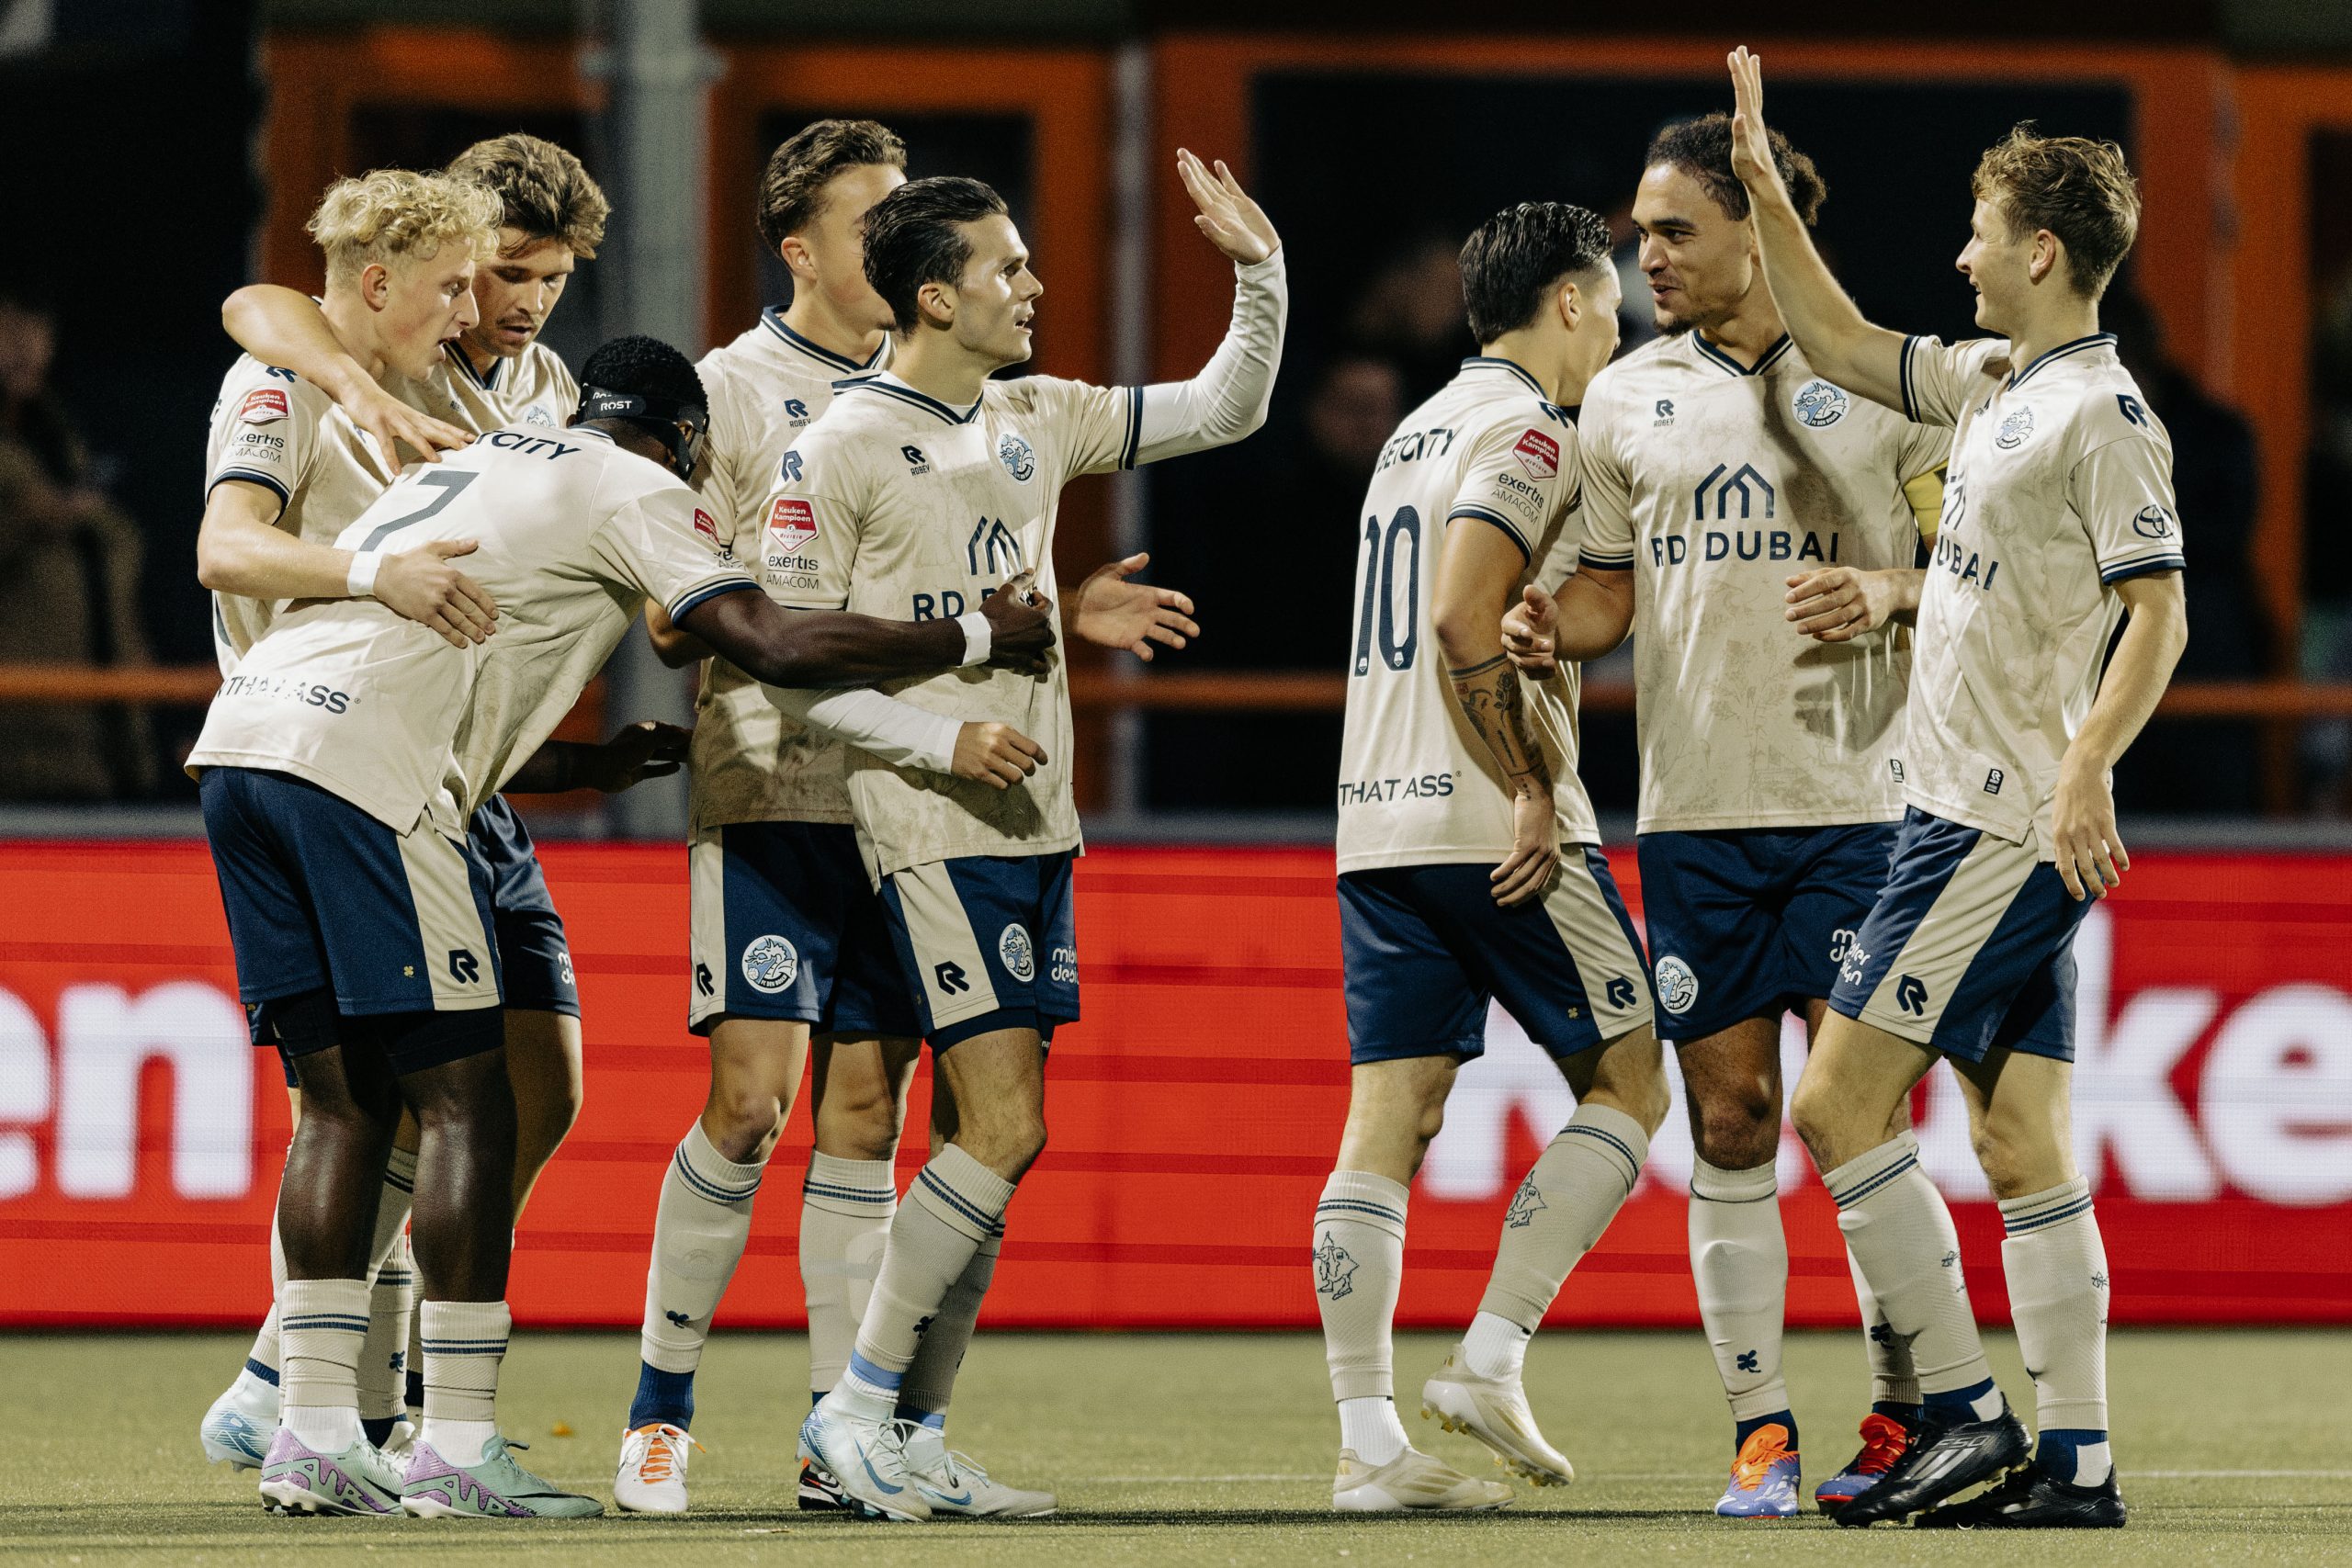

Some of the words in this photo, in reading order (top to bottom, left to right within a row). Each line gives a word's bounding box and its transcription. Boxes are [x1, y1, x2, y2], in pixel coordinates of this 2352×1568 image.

[1522, 439, 1557, 464] Kampioen
[1529, 434, 1556, 454] Keuken
[1498, 473, 1544, 510] exertis
[357, 469, 481, 552] 7
[774, 513, 811, 524] Kampioen
[778, 505, 807, 515] Keuken
[1491, 488, 1539, 525] AMACOM
[768, 555, 819, 570] exertis
[1651, 535, 1687, 568] RD
[1705, 531, 1839, 563] DUBAI
[765, 573, 820, 591] AMACOM
[1354, 505, 1421, 677] 10
[912, 591, 965, 622] RD
[1340, 778, 1401, 807] THAT
